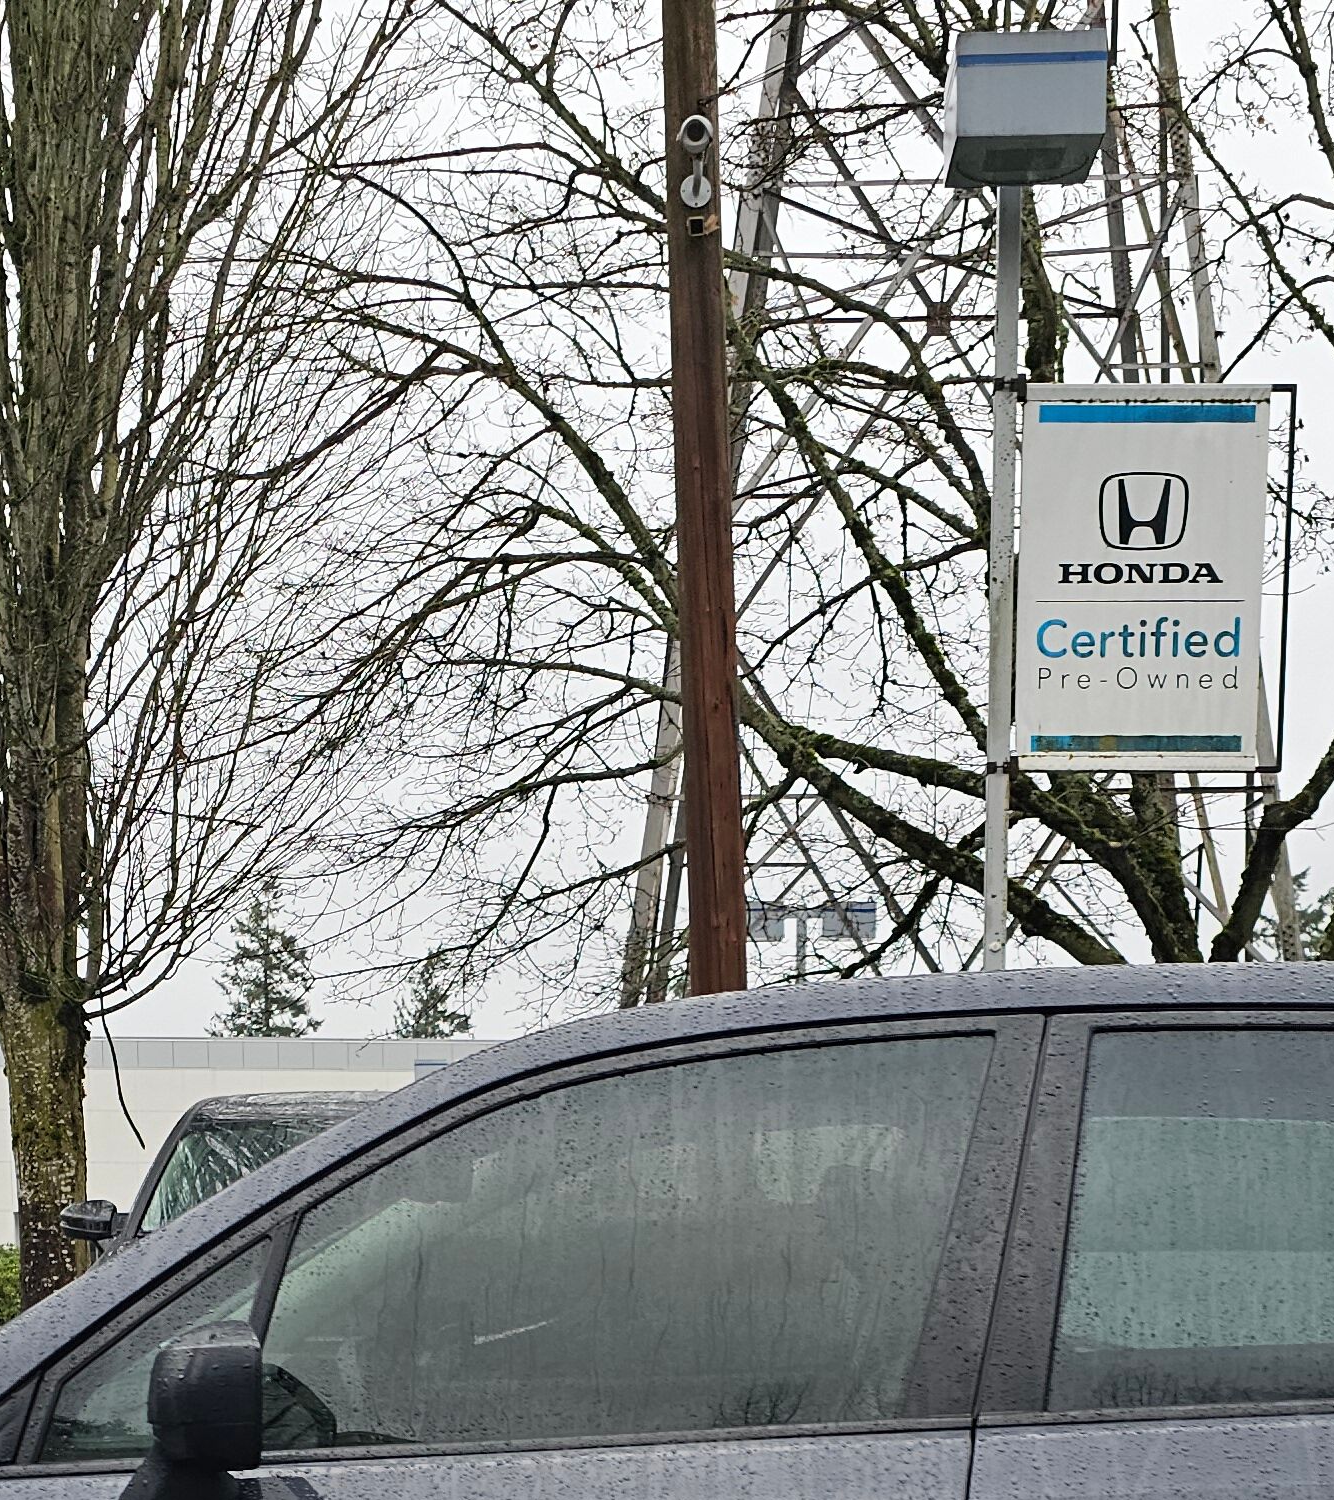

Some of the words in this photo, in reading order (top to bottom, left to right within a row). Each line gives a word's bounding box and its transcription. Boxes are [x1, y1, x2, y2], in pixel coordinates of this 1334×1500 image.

[1058, 562, 1224, 585] HONDA
[1036, 616, 1242, 658] Certified
[1037, 665, 1239, 690] Pre-Owned
